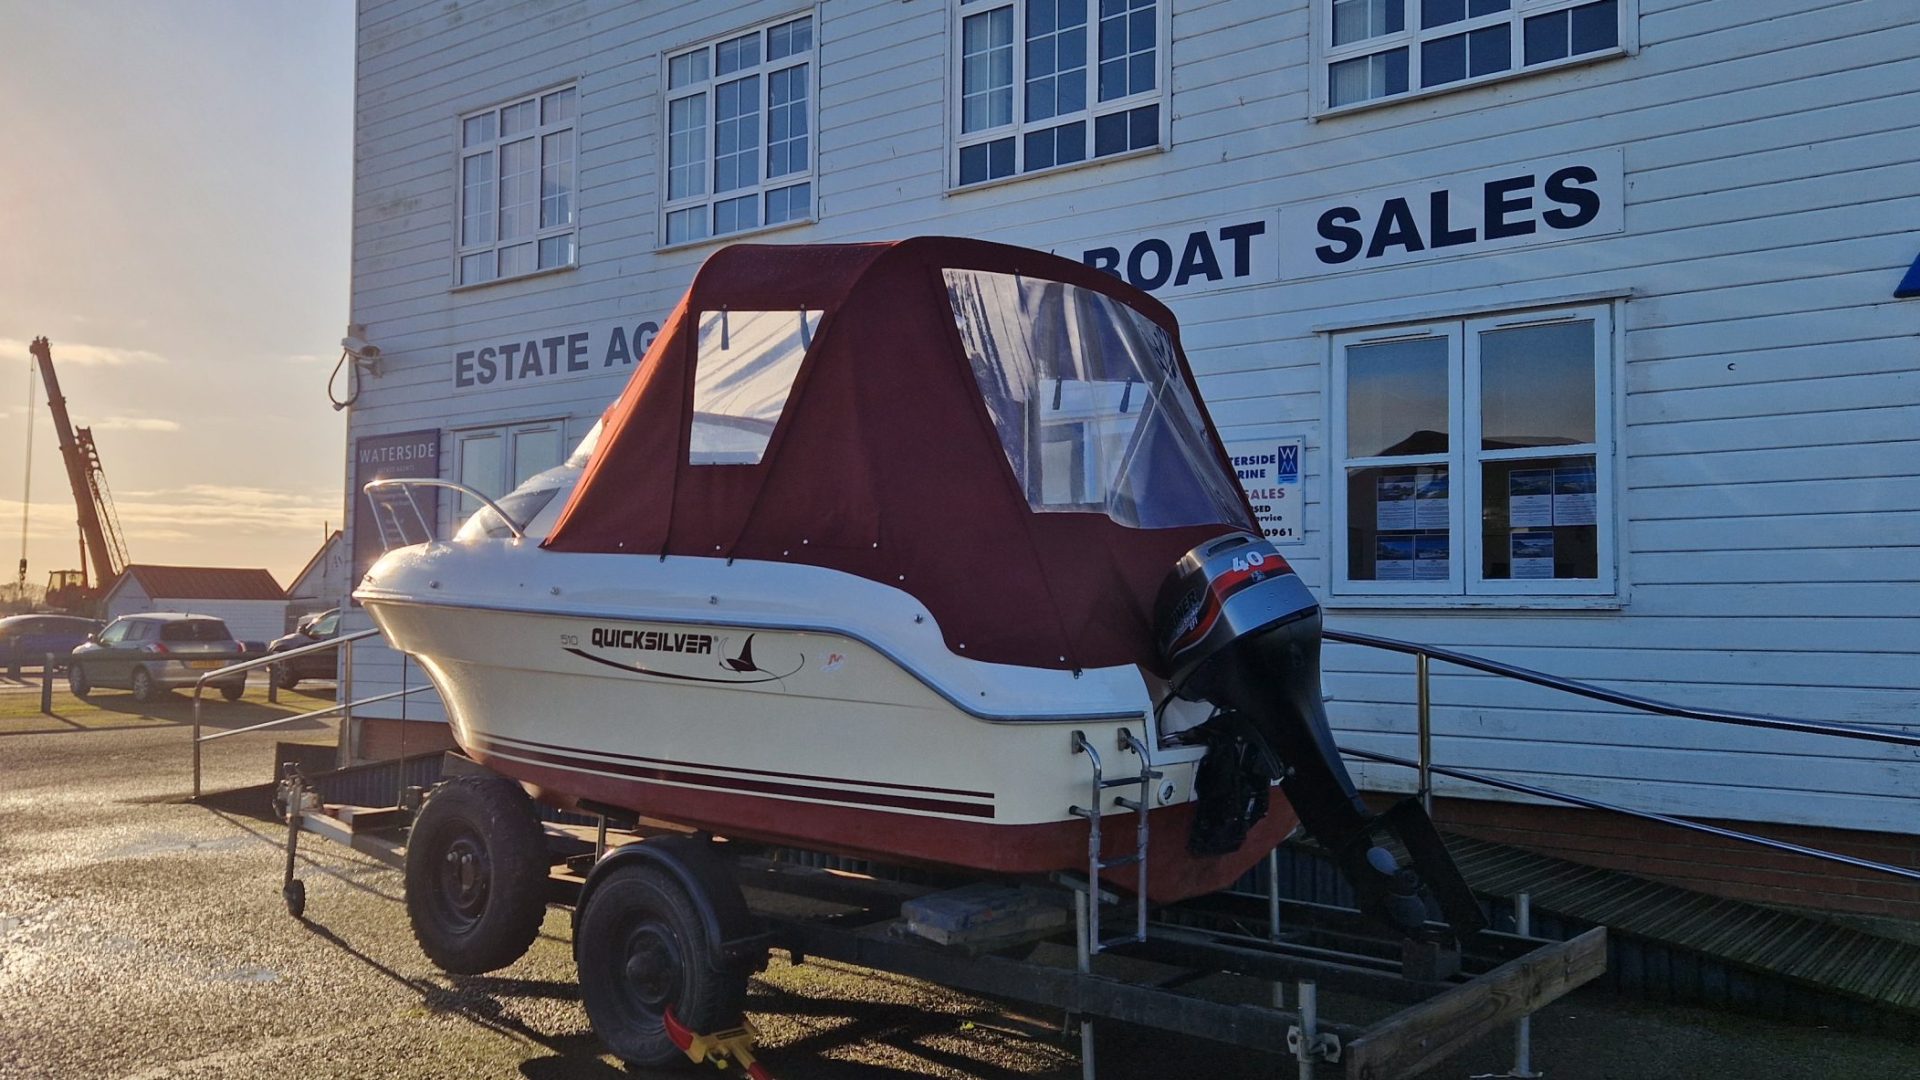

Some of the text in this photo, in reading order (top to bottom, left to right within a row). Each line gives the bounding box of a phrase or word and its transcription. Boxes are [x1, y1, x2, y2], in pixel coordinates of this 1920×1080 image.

[1083, 165, 1600, 292] BOAT SALES
[456, 319, 667, 388] ESTATE AG
[360, 443, 435, 463] WATERSIDE
[1232, 551, 1265, 572] 40
[591, 628, 712, 655] QUICKSILVER
